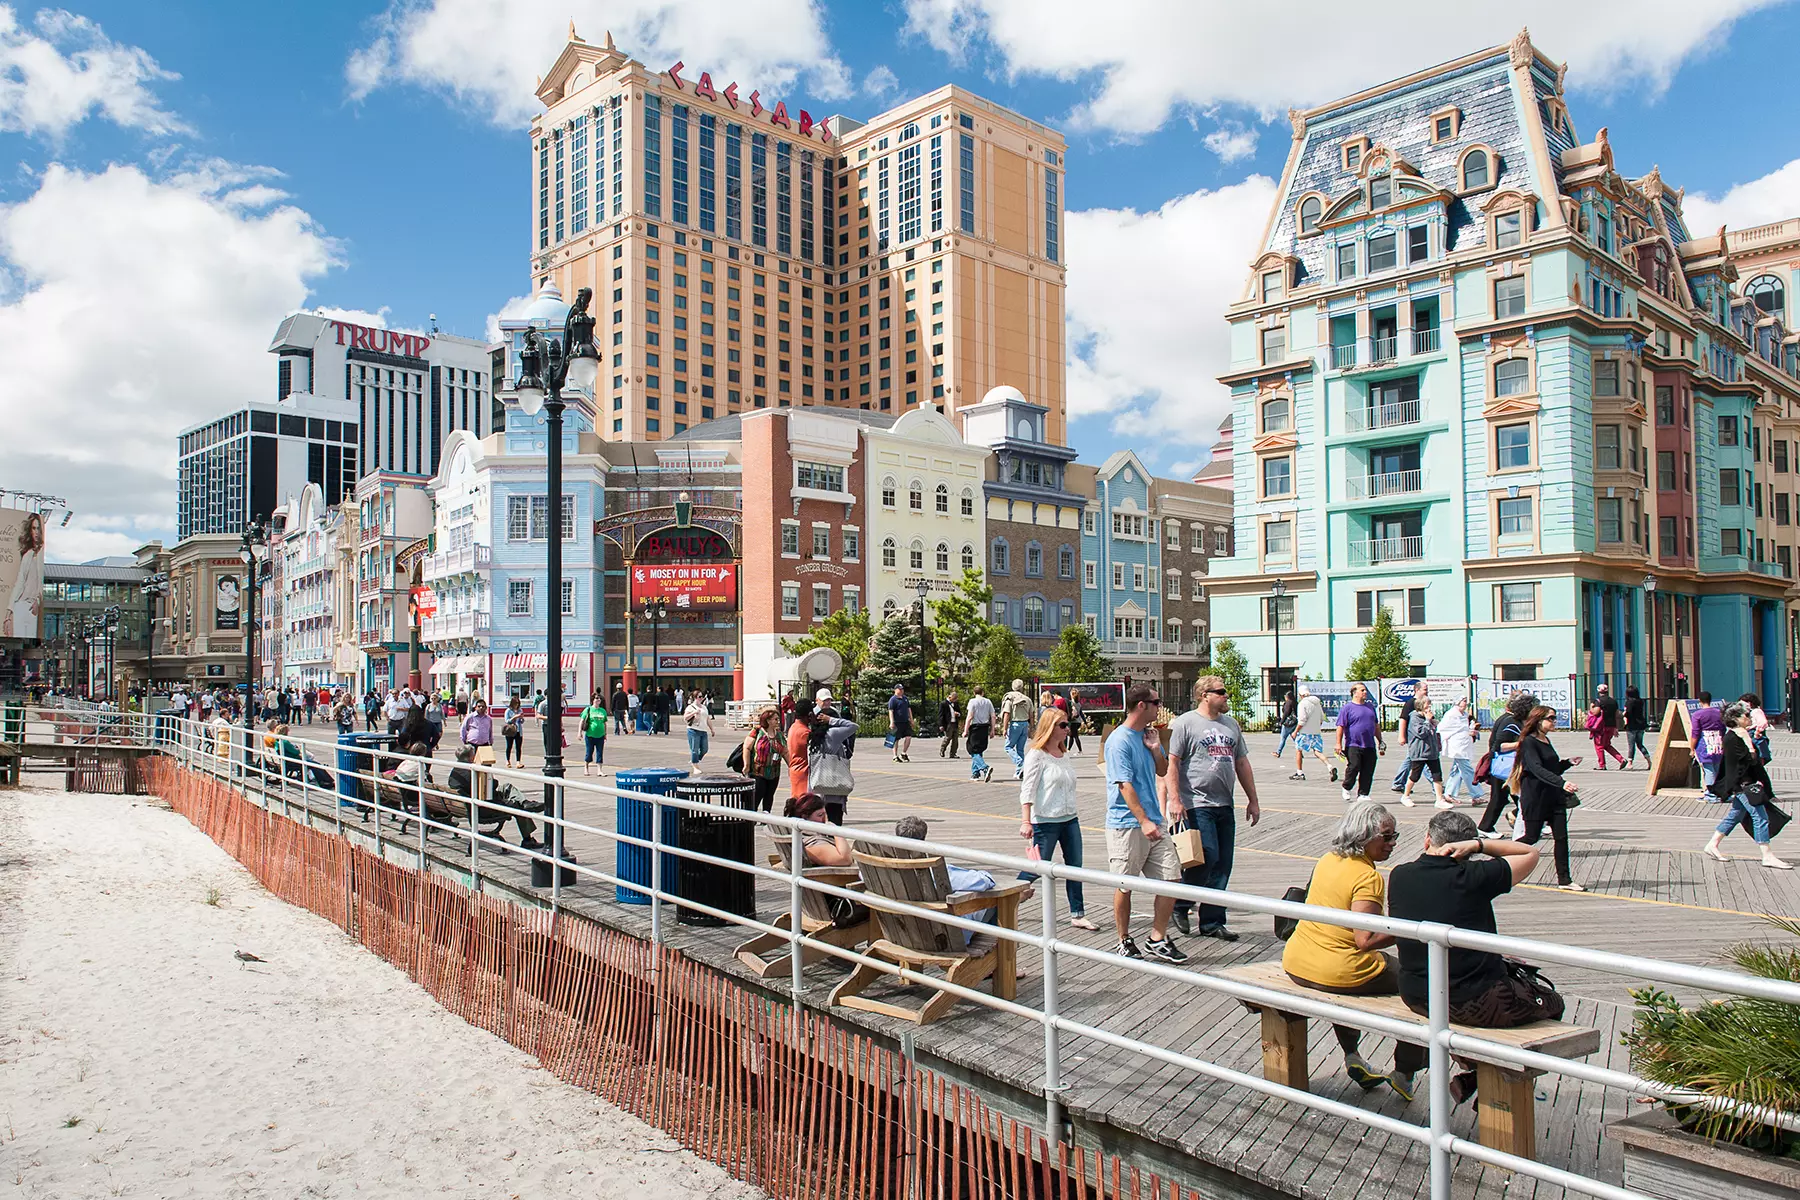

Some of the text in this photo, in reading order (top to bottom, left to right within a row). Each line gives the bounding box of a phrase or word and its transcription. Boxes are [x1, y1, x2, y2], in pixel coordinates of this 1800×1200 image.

[668, 60, 834, 143] CAESARS
[330, 320, 430, 358] TRUMP
[650, 569, 716, 579] MOSEY ON IN FOR
[795, 562, 848, 578] PIONEER GROCERY
[1118, 666, 1135, 675] MEAT
[1136, 666, 1150, 675] SHOP
[1492, 682, 1518, 698] TEN
[1200, 734, 1216, 748] NEW
